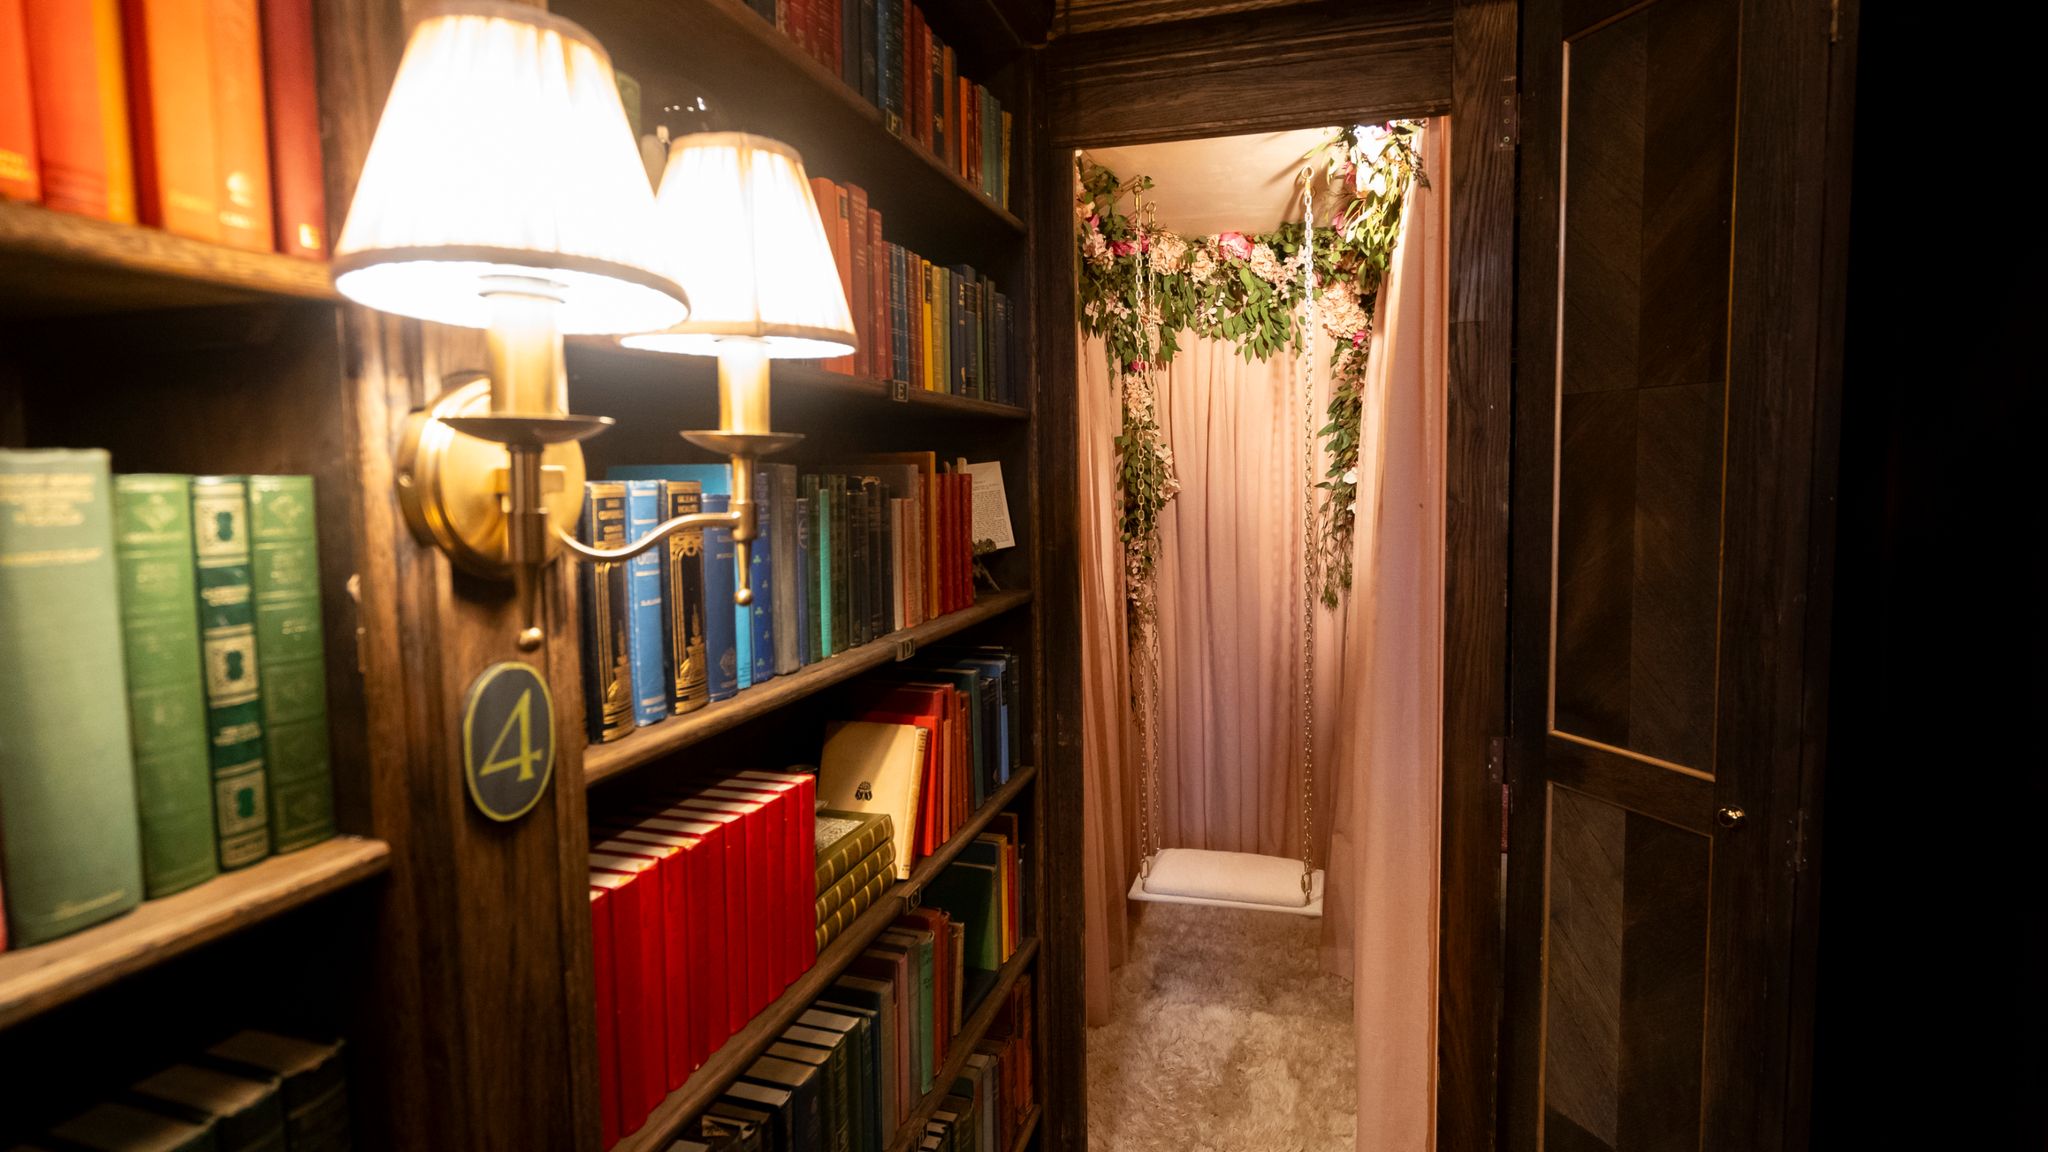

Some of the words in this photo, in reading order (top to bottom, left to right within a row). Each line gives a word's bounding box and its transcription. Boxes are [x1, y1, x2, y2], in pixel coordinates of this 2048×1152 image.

[897, 383, 905, 399] E
[904, 639, 912, 657] D
[478, 688, 543, 782] 4
